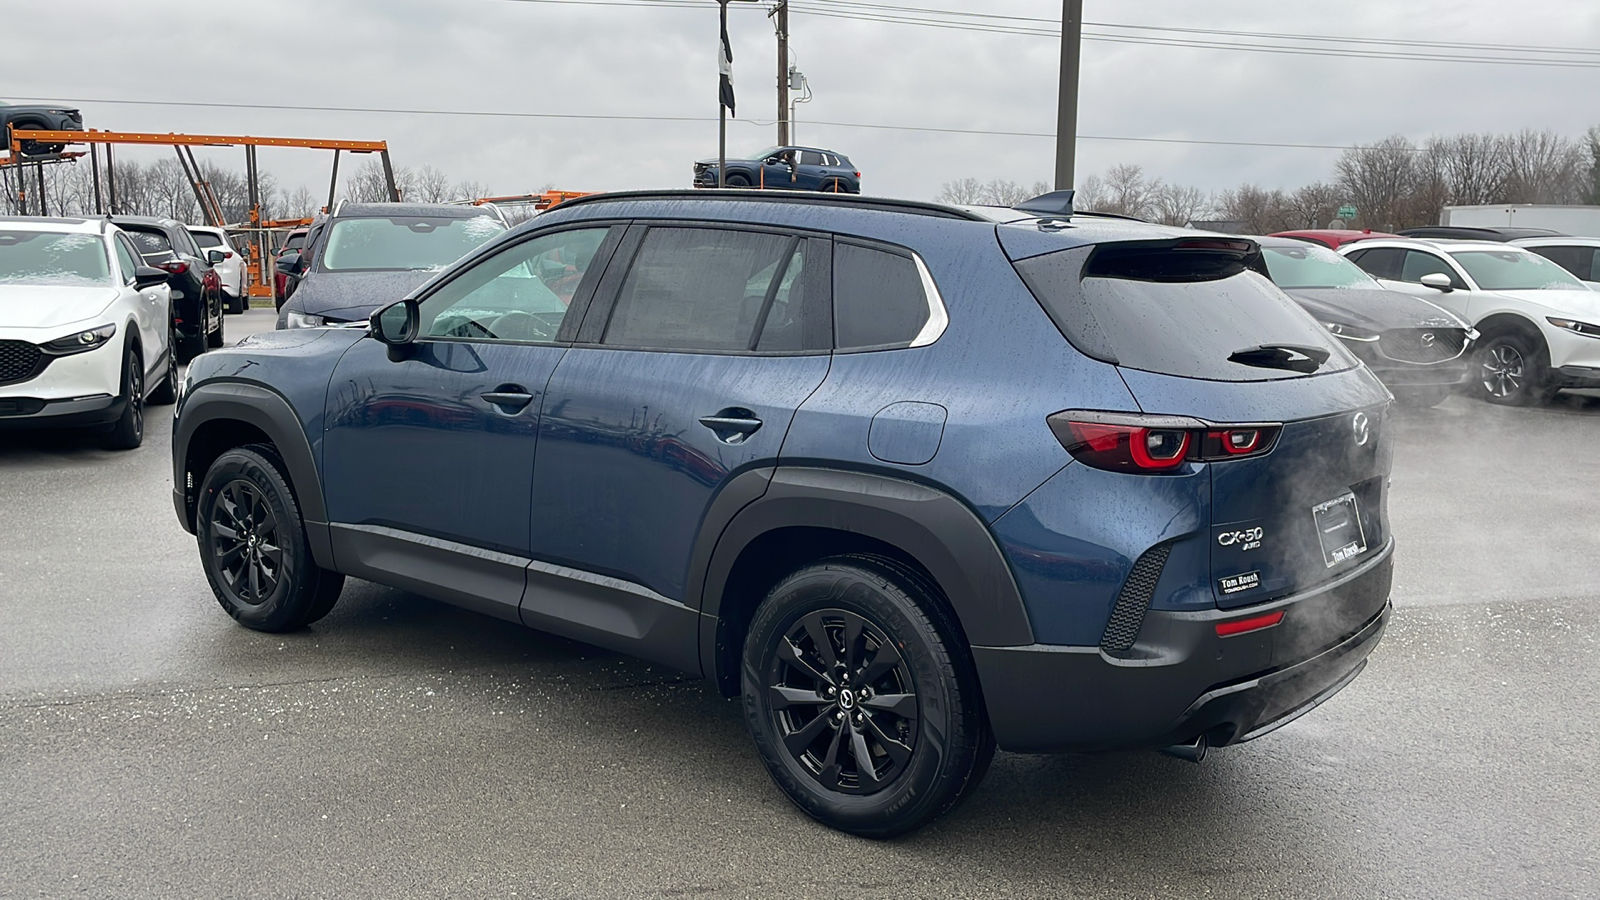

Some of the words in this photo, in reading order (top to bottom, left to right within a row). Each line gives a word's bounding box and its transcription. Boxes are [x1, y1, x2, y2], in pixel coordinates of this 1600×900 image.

[1218, 526, 1264, 546] CX-50
[1331, 551, 1346, 563] Tom
[1342, 542, 1359, 558] Roush
[1221, 579, 1238, 589] Tom
[1238, 573, 1259, 586] Roush
